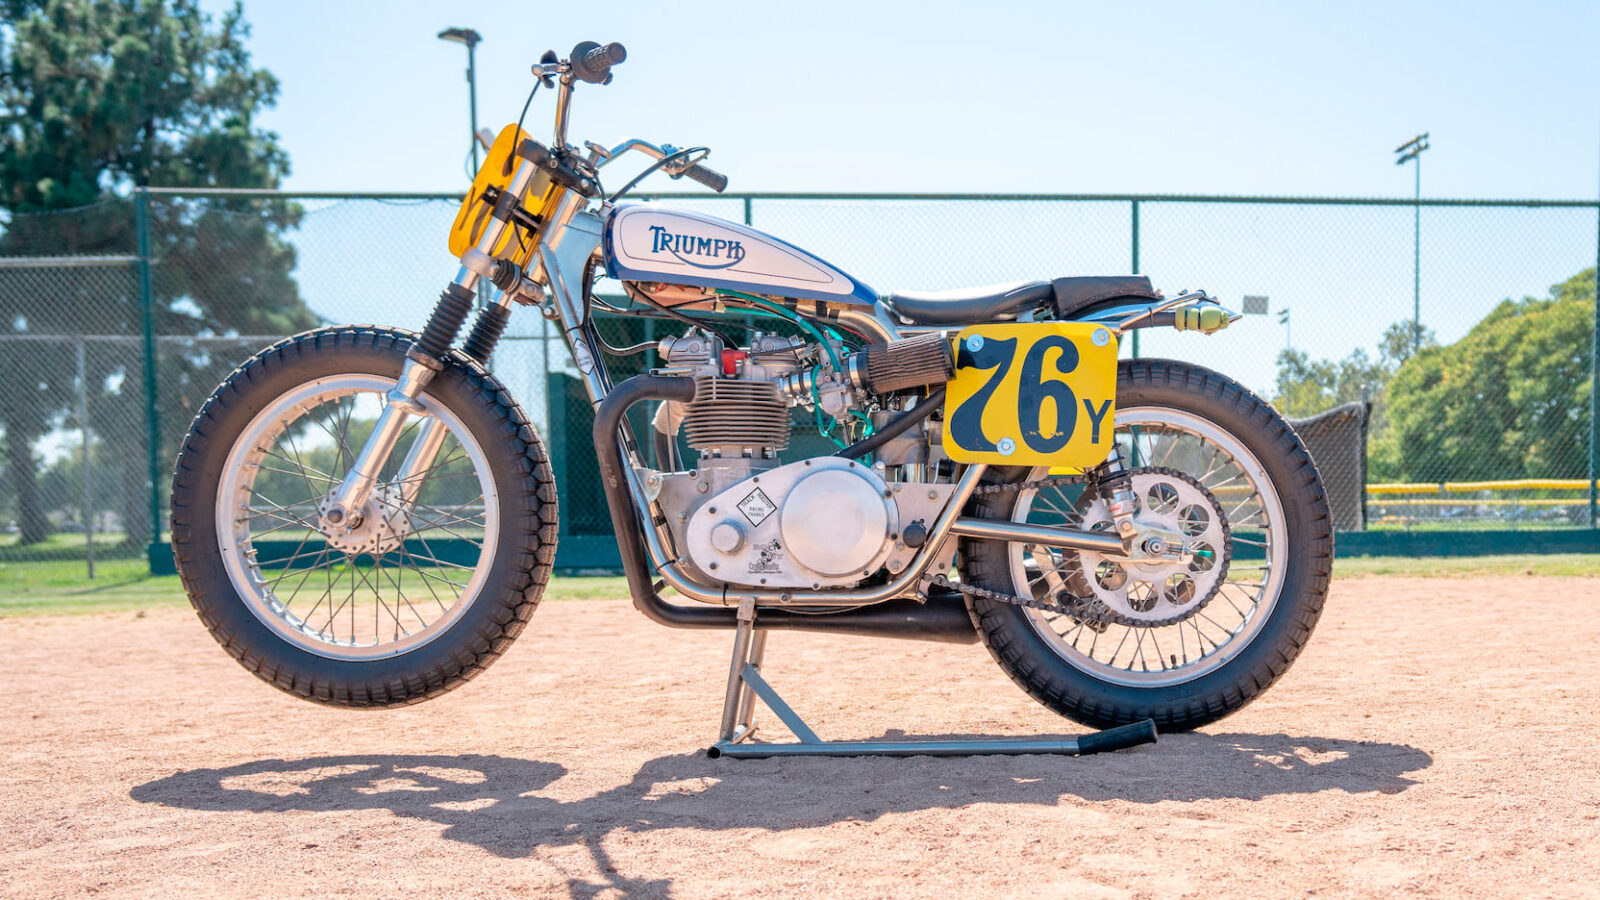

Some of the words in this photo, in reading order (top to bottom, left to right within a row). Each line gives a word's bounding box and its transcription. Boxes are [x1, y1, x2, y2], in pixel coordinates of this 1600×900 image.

[649, 225, 746, 269] TRIUMPH
[741, 495, 756, 508] TRACK
[757, 492, 773, 510] MASTER
